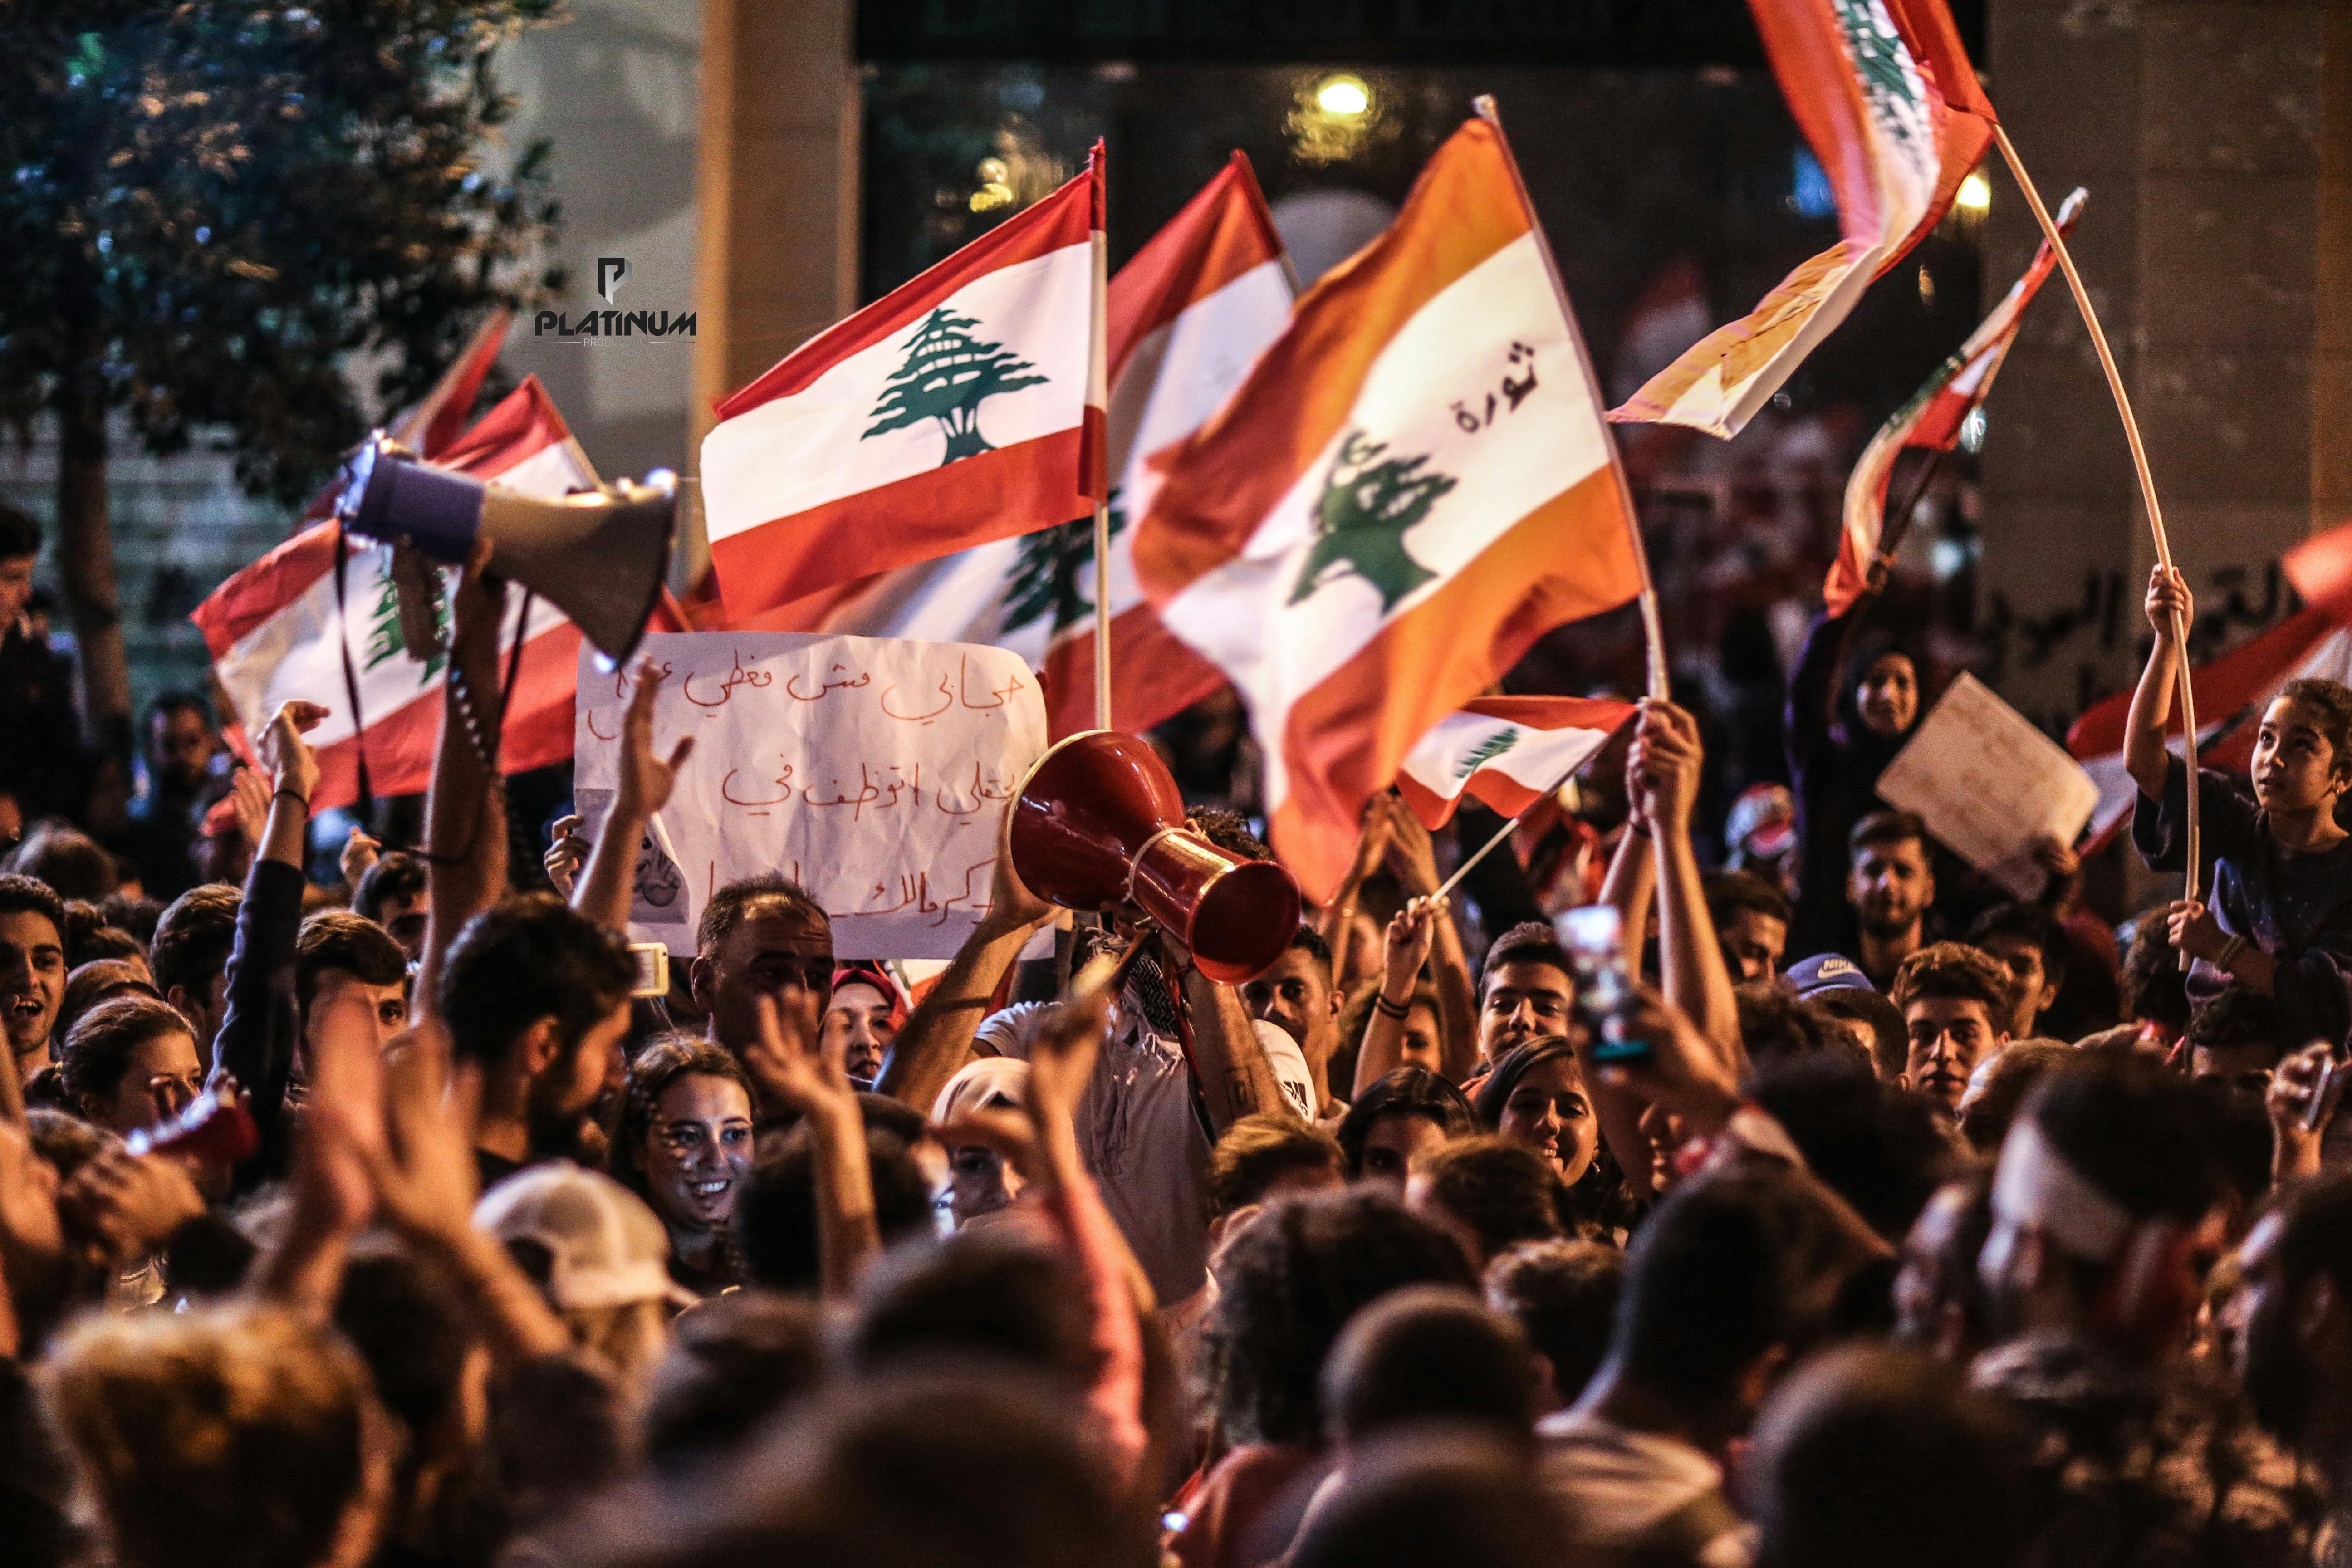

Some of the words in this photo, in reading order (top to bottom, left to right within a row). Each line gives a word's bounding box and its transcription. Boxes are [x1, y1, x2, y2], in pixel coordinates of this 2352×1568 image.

[1450, 340, 1538, 434] ثورة
[684, 647, 772, 718] مغطي
[787, 664, 870, 701] مش
[722, 754, 793, 816] في
